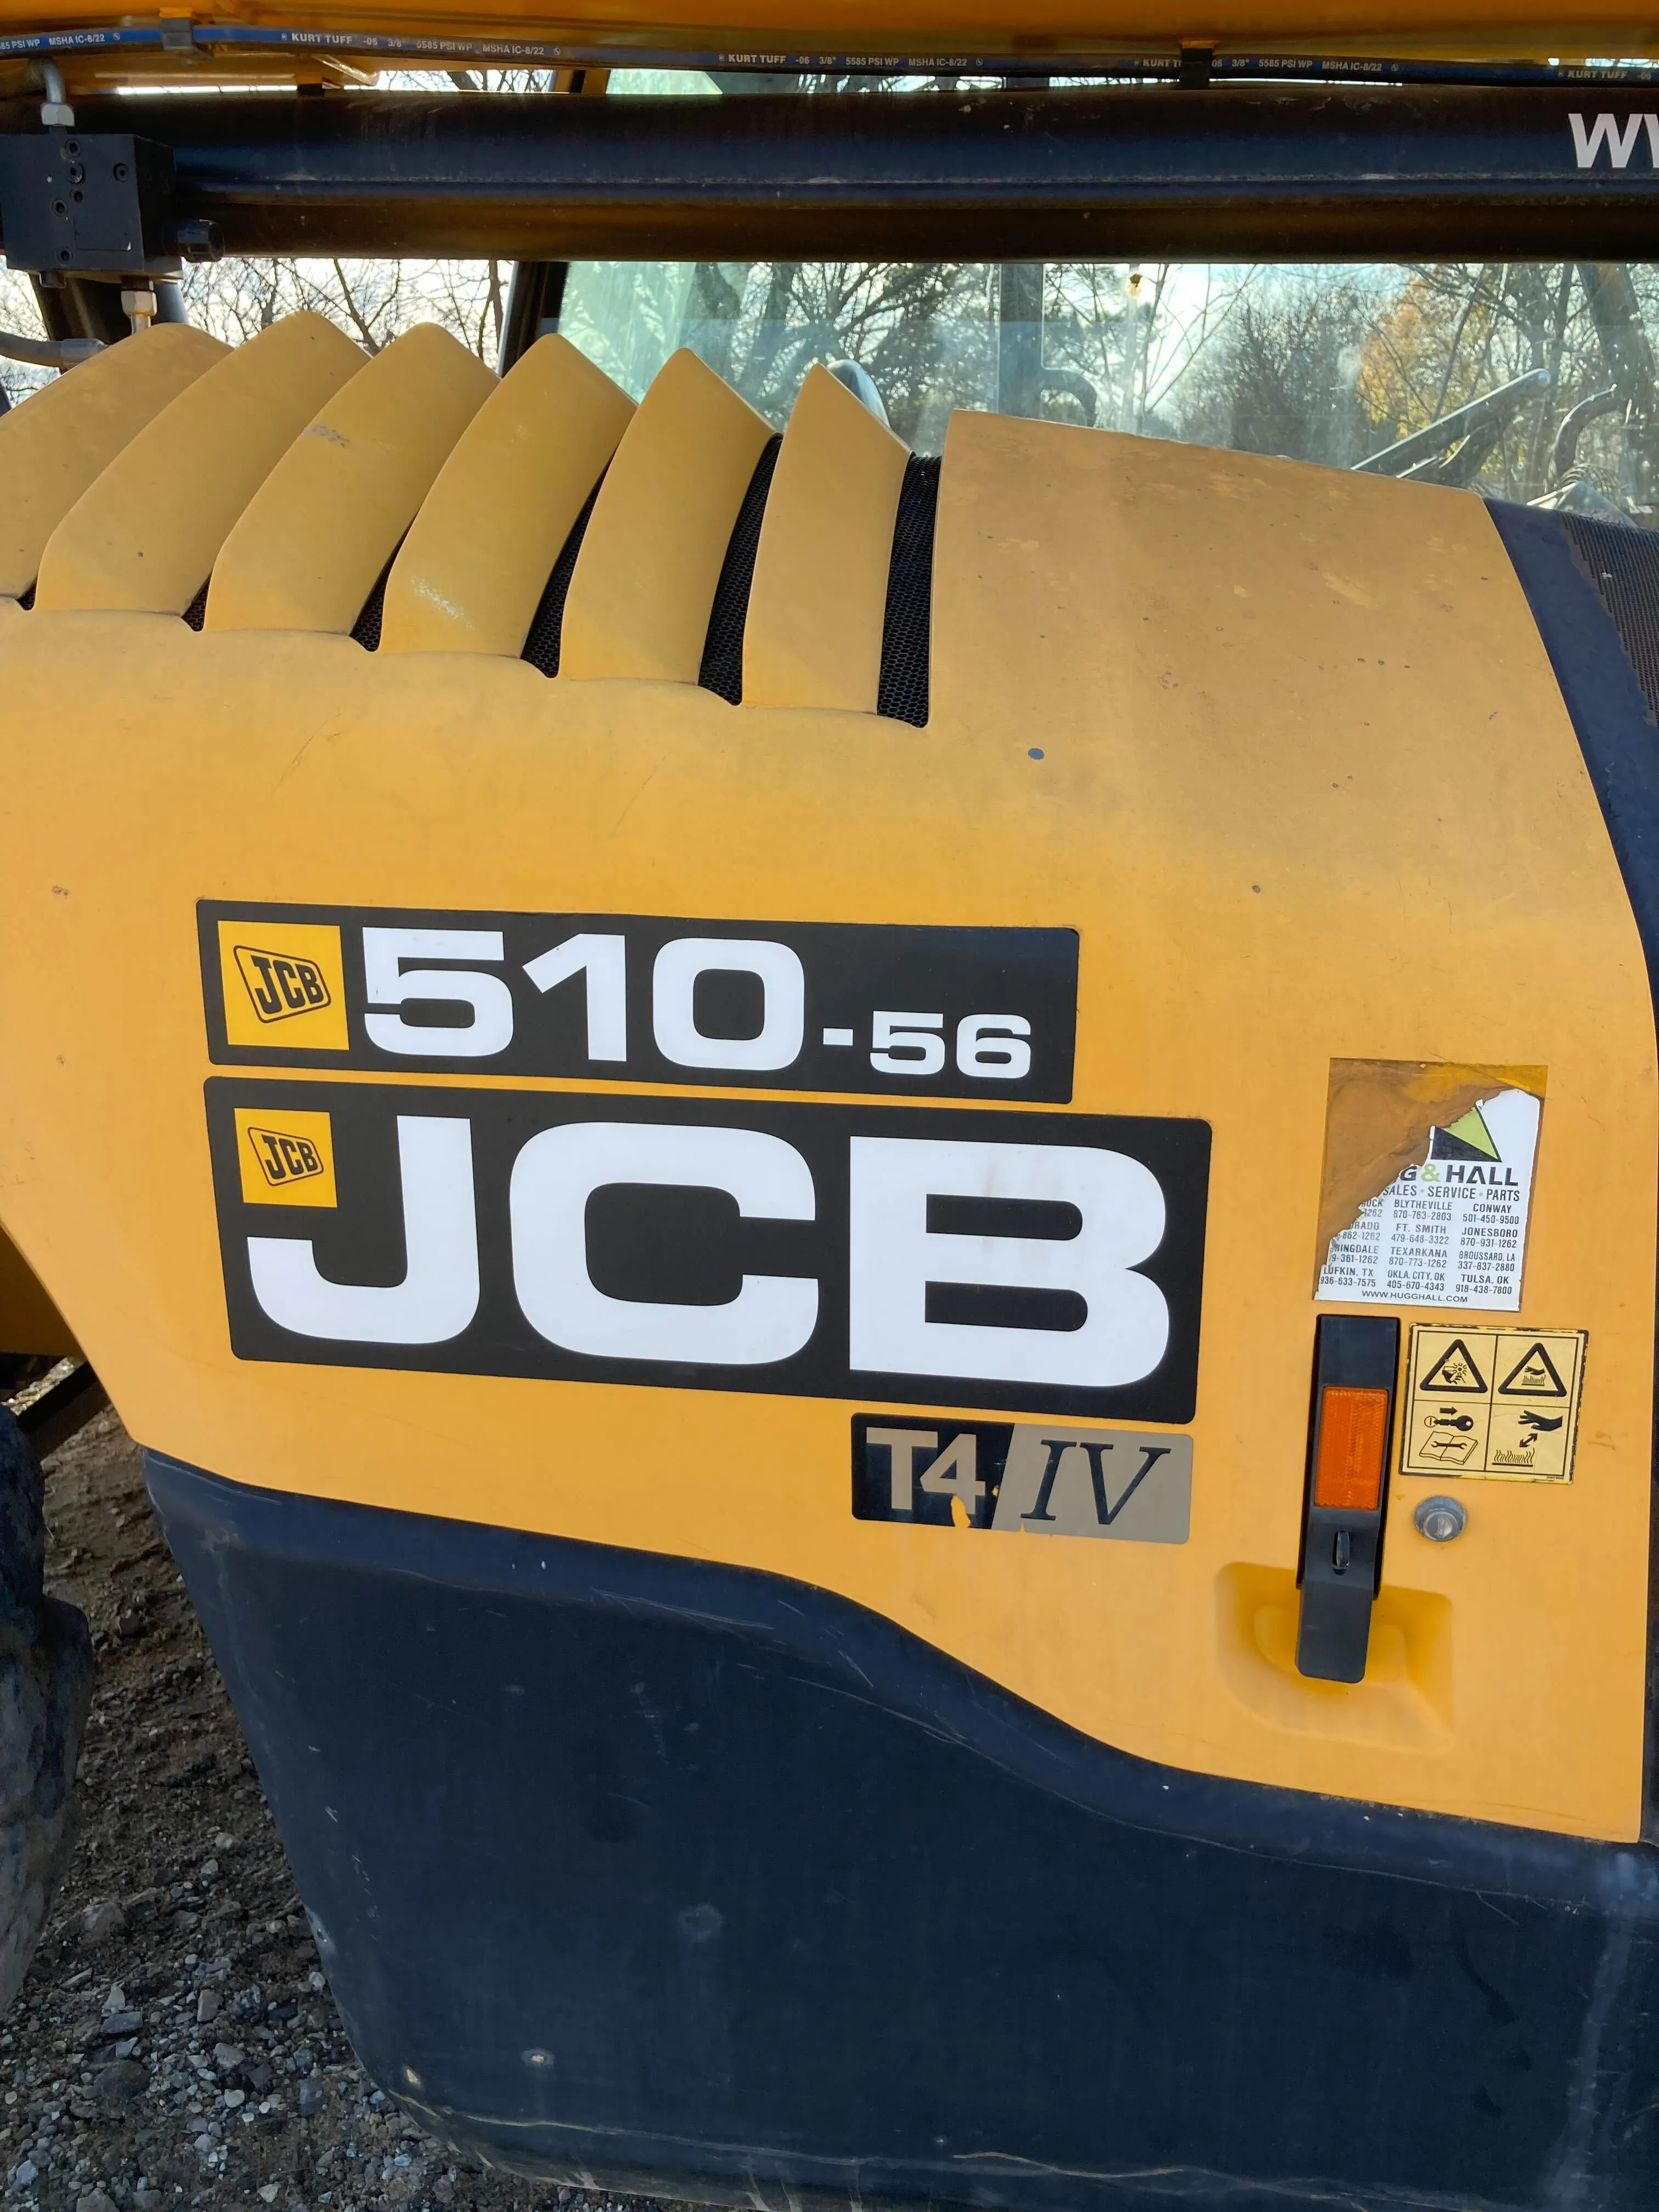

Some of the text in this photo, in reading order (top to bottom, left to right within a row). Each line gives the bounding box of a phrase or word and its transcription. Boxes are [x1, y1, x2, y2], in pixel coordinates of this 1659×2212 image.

[0, 42, 10, 50] 85
[12, 40, 26, 48] PSI
[26, 39, 40, 47] WP
[49, 36, 73, 46] MSHA
[291, 33, 321, 43] KURT
[325, 35, 353, 44] TUFF
[363, 37, 378, 46] -06
[416, 40, 438, 50] 5585
[440, 42, 455, 50] PSI
[457, 43, 472, 52] WP
[482, 44, 510, 54] MSHA
[729, 54, 757, 63] KURT
[759, 55, 786, 64] TUFF
[795, 56, 810, 65] -06
[845, 57, 866, 65] 5585
[868, 57, 883, 66] PSI
[884, 58, 899, 66] WP
[909, 58, 935, 66] MSHA
[1143, 59, 1171, 67] KURT
[1259, 59, 1279, 67] 5585
[1282, 59, 1296, 68] PSI
[1298, 60, 1313, 69] WP
[1322, 61, 1348, 70] MSHA
[1568, 70, 1599, 78] KURT
[1600, 71, 1628, 80] TUFF
[250, 955, 324, 1014] JCB
[362, 926, 1031, 1079] 510-56
[262, 1134, 318, 1180] JCB
[1446, 1164, 1519, 1186] HALL
[1383, 1184, 1520, 1201] SALES SERVICE PARTS
[1394, 1199, 1453, 1210] BLYTHEVILLE
[1473, 1203, 1512, 1214] CONWAY
[1393, 1210, 1452, 1221] 870-763-2803
[1463, 1214, 1519, 1224] 501-450-9500
[1396, 1223, 1446, 1234] FT. SMITH
[1461, 1227, 1518, 1238] JONESBORO
[1391, 1233, 1449, 1244] 479-648-3322
[1460, 1237, 1517, 1248] 870-931-1262
[247, 1114, 1170, 1387] JCB
[1391, 1246, 1447, 1258] TEXARKANA
[1389, 1256, 1447, 1268] 870-773-1262
[1506, 1253, 1515, 1262] LA
[1458, 1261, 1515, 1272] 337-837-2880
[1362, 1268, 1374, 1277] TX
[1434, 1272, 1445, 1281] OK
[1321, 1276, 1376, 1287] 936-633-7575
[1387, 1280, 1444, 1291] 405-670-4343
[1497, 1276, 1509, 1284] OK
[1455, 1284, 1512, 1295] 918-438-7800
[1362, 1290, 1468, 1302] WWW.HUGGHALL.COM
[866, 1427, 1171, 1525] T4 IV
